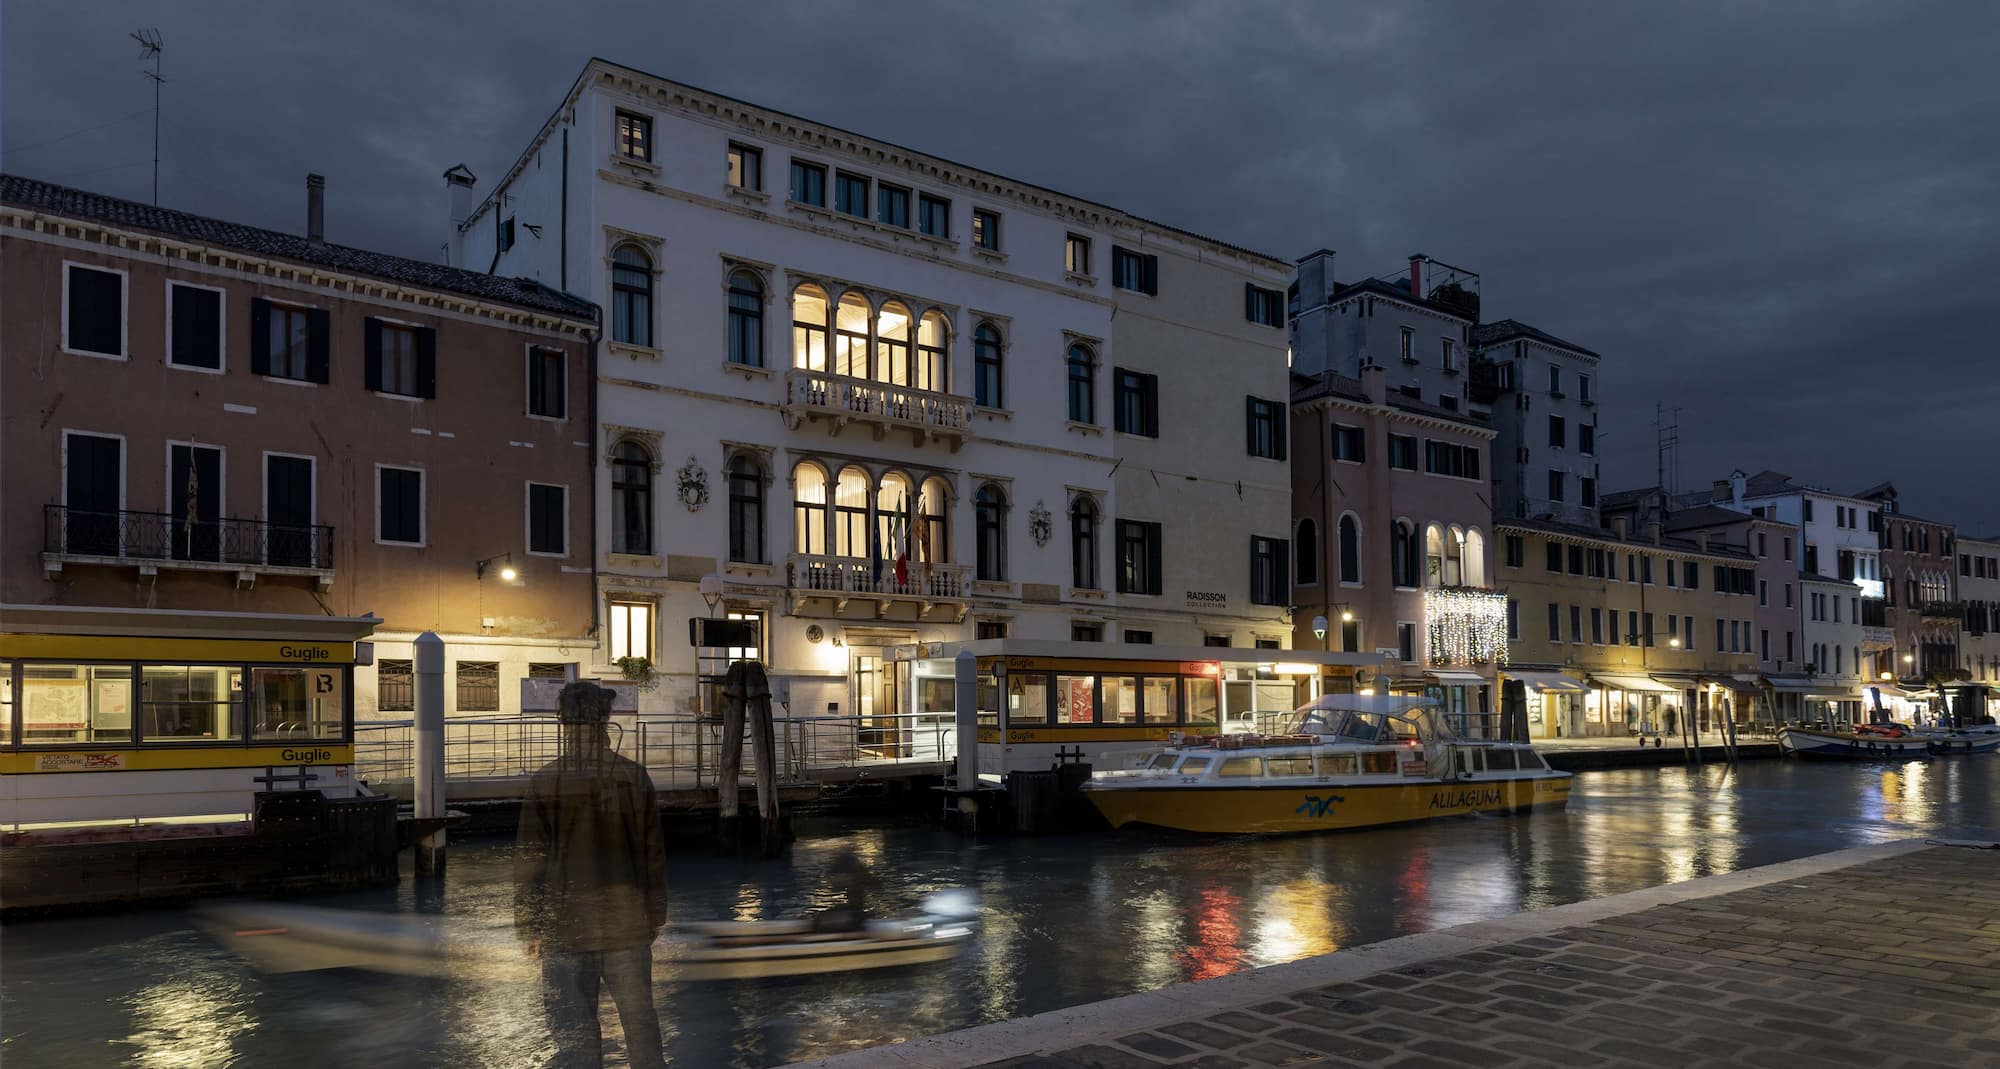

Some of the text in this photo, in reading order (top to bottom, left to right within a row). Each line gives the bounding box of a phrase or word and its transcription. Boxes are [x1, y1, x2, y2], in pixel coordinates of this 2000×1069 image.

[1186, 591, 1226, 602] RADISSON
[280, 646, 329, 661] Guglie
[316, 674, 333, 693] B
[1012, 676, 1024, 692] A
[282, 748, 331, 764] Guglie
[1429, 789, 1502, 808] ALILAGUNA
